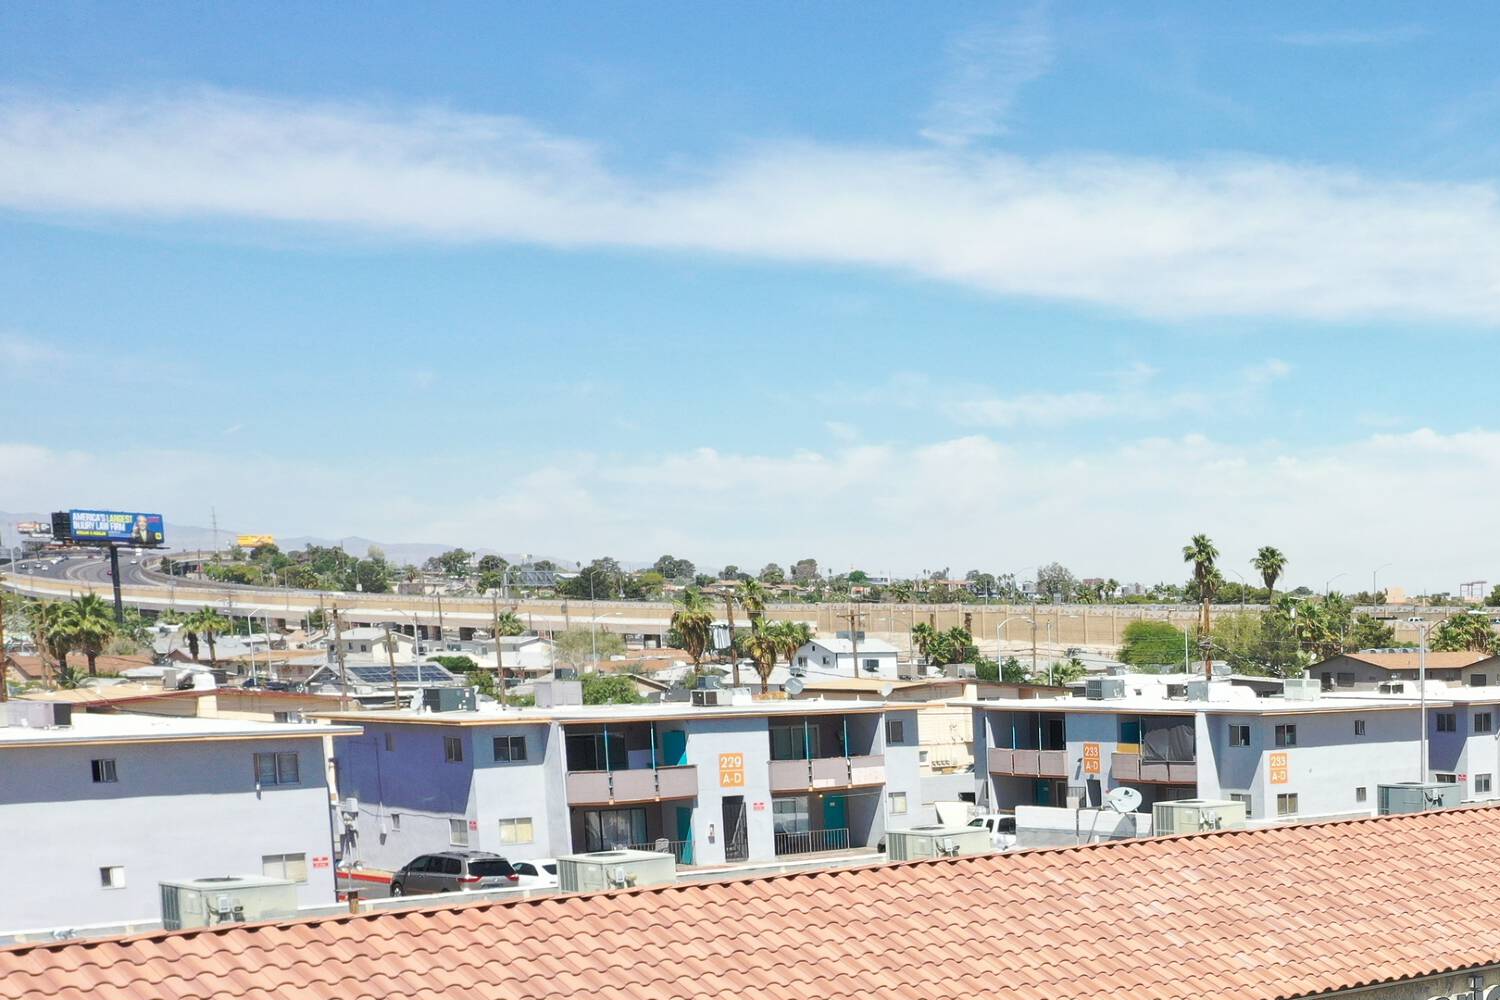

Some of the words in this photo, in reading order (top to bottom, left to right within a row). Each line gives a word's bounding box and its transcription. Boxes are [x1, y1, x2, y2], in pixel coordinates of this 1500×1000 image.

[1085, 746, 1098, 757] 233
[721, 755, 742, 768] 229
[722, 772, 742, 784] A-D
